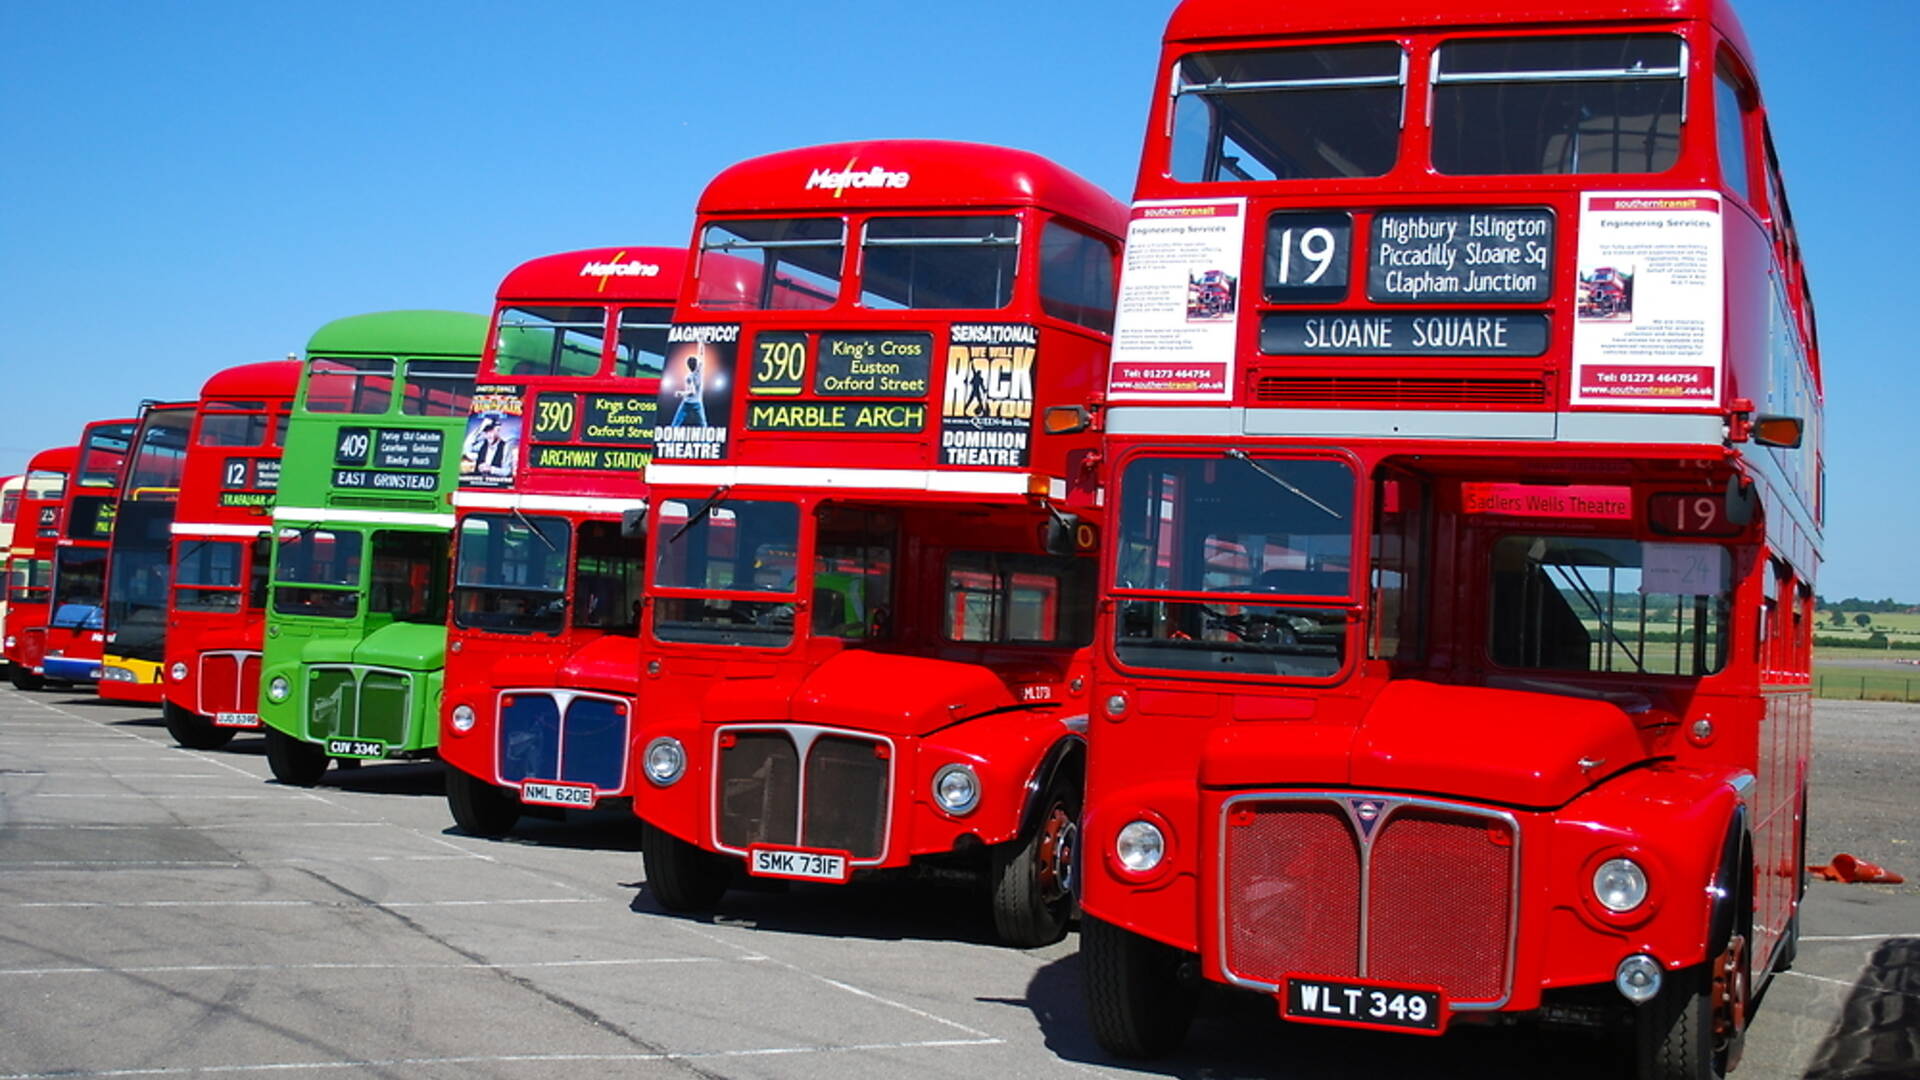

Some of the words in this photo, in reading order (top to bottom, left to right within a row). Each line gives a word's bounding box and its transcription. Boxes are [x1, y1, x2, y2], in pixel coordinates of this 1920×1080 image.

[804, 162, 910, 192] Metroline
[1143, 207, 1215, 218] southerntransit
[1614, 199, 1696, 209] southerntransit
[1131, 226, 1185, 235] Engineering
[1188, 225, 1226, 233] Services
[1381, 218, 1457, 244] Highbury
[1470, 215, 1546, 241] Islington
[1600, 220, 1663, 229] Engineering
[1666, 219, 1711, 228] Services
[1279, 228, 1335, 284] 19
[1380, 244, 1457, 270] Piccadilly
[1465, 242, 1520, 265] Sloane
[1525, 241, 1546, 270] Sq
[1386, 271, 1458, 299] Clapham
[1463, 272, 1537, 293] Junction
[1304, 318, 1392, 347] SLOANE
[1412, 317, 1508, 347] SQUARE
[832, 341, 875, 359] King's
[880, 341, 922, 355] Cross
[757, 342, 805, 382] 390
[851, 360, 899, 374] Euston
[1143, 369, 1173, 378] 01273
[1619, 373, 1654, 382] 01273
[824, 376, 875, 390] Oxford
[880, 377, 925, 391] Street
[627, 399, 657, 411] Cross
[987, 399, 1032, 419] YOU
[535, 402, 573, 432] 390
[607, 411, 643, 424] Euston
[753, 406, 845, 427] MARBLE
[855, 406, 923, 427] ARCH
[587, 425, 625, 437] Oxford
[627, 426, 654, 438] Stree
[654, 426, 727, 443] DOMINION
[942, 430, 1026, 449] DOMINION
[340, 435, 368, 457] 409
[656, 442, 720, 459] THEATRE
[539, 449, 598, 467] ARCHWAY
[947, 448, 1019, 466] THEATRE
[227, 463, 245, 484] 12
[338, 471, 365, 486] EAST
[374, 473, 435, 489] GRINSTEAD
[1468, 494, 1522, 512] Sadlers
[1527, 495, 1564, 512] Wells
[1569, 495, 1627, 515] Theatre
[1677, 498, 1716, 530] 19
[526, 786, 552, 800] NML
[556, 788, 590, 803] 620E
[759, 853, 794, 871] SMK
[800, 856, 840, 875] 731F
[1300, 984, 1363, 1015] WLT
[1369, 991, 1427, 1021] 349
